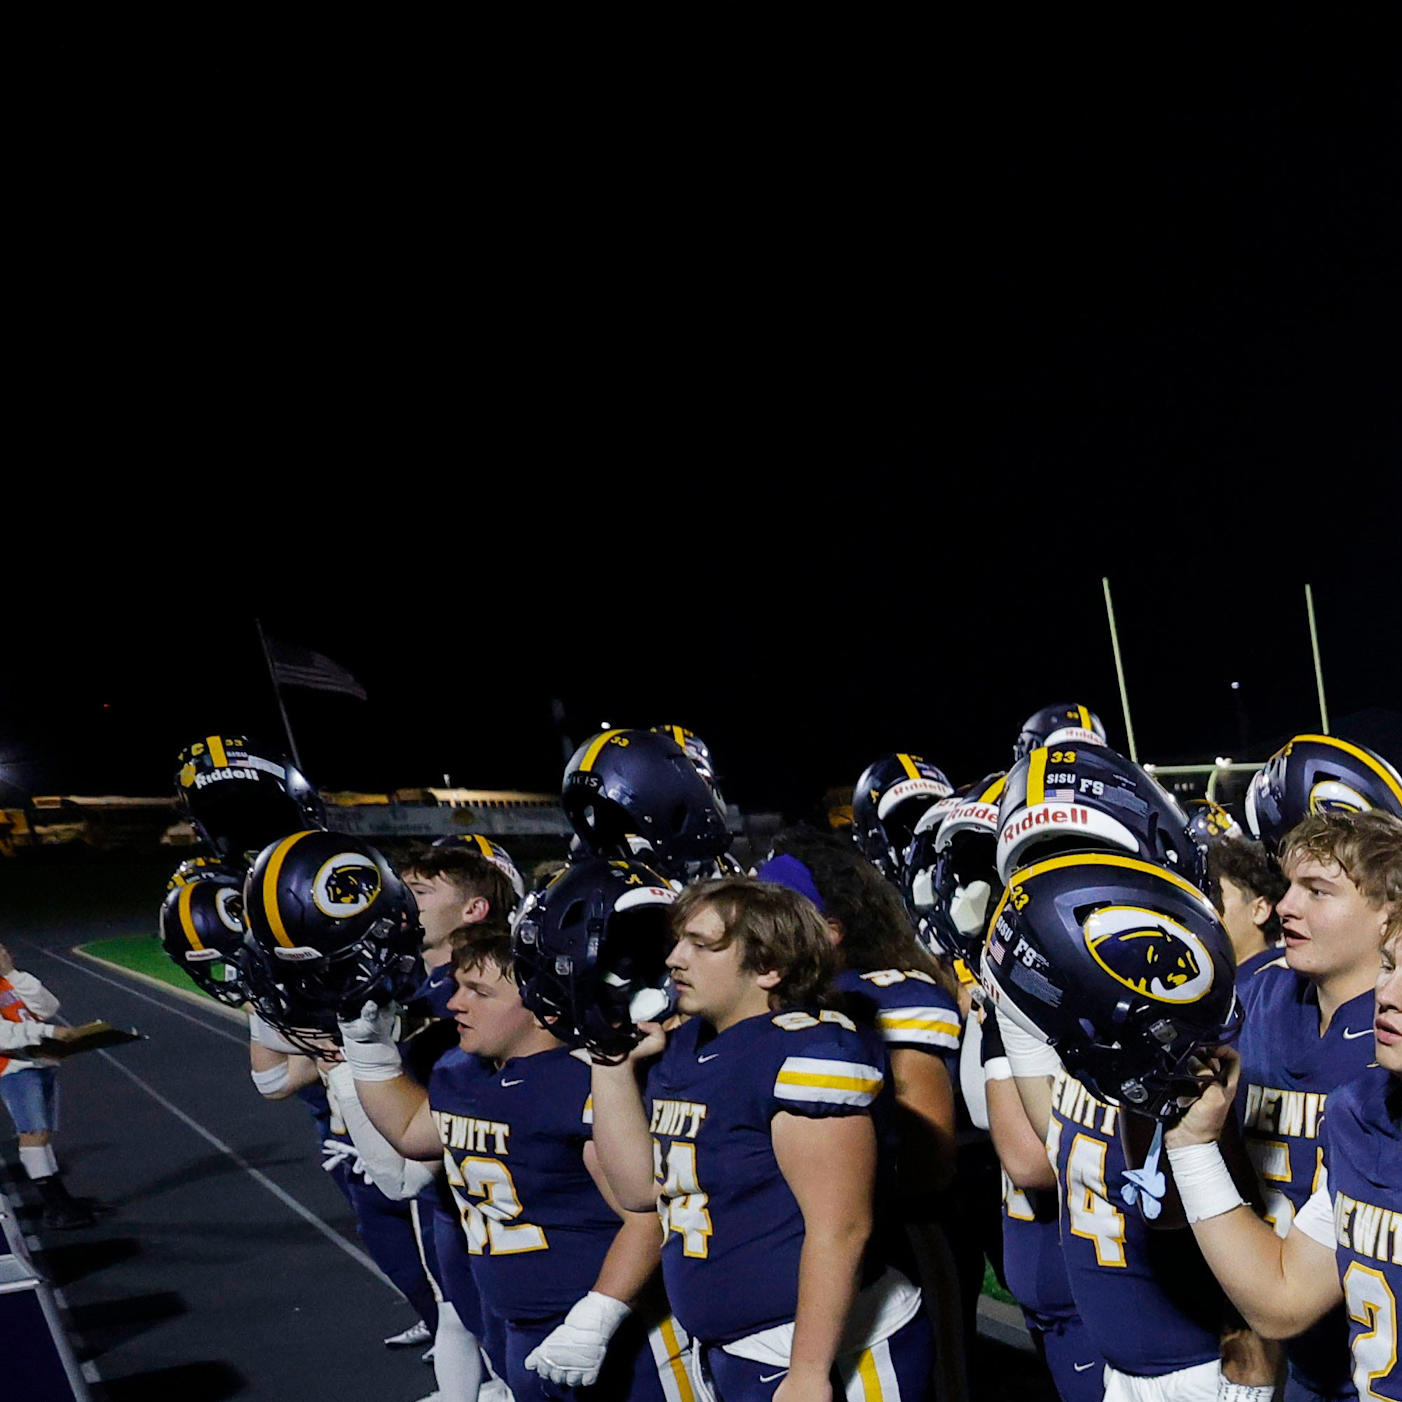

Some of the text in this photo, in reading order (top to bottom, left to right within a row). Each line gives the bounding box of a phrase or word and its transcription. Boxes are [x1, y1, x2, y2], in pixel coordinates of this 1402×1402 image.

[610, 736, 629, 747] 33
[1051, 751, 1076, 763] 33
[194, 767, 260, 789] Riddell
[1046, 773, 1076, 784] SISU
[1079, 778, 1104, 796] FS
[948, 806, 999, 824] Ridde
[1003, 807, 1088, 844] Riddell
[1013, 937, 1036, 967] FS
[1051, 1070, 1120, 1136] EWITT
[1244, 1083, 1327, 1139] DEWI
[650, 1098, 707, 1138] EWITT
